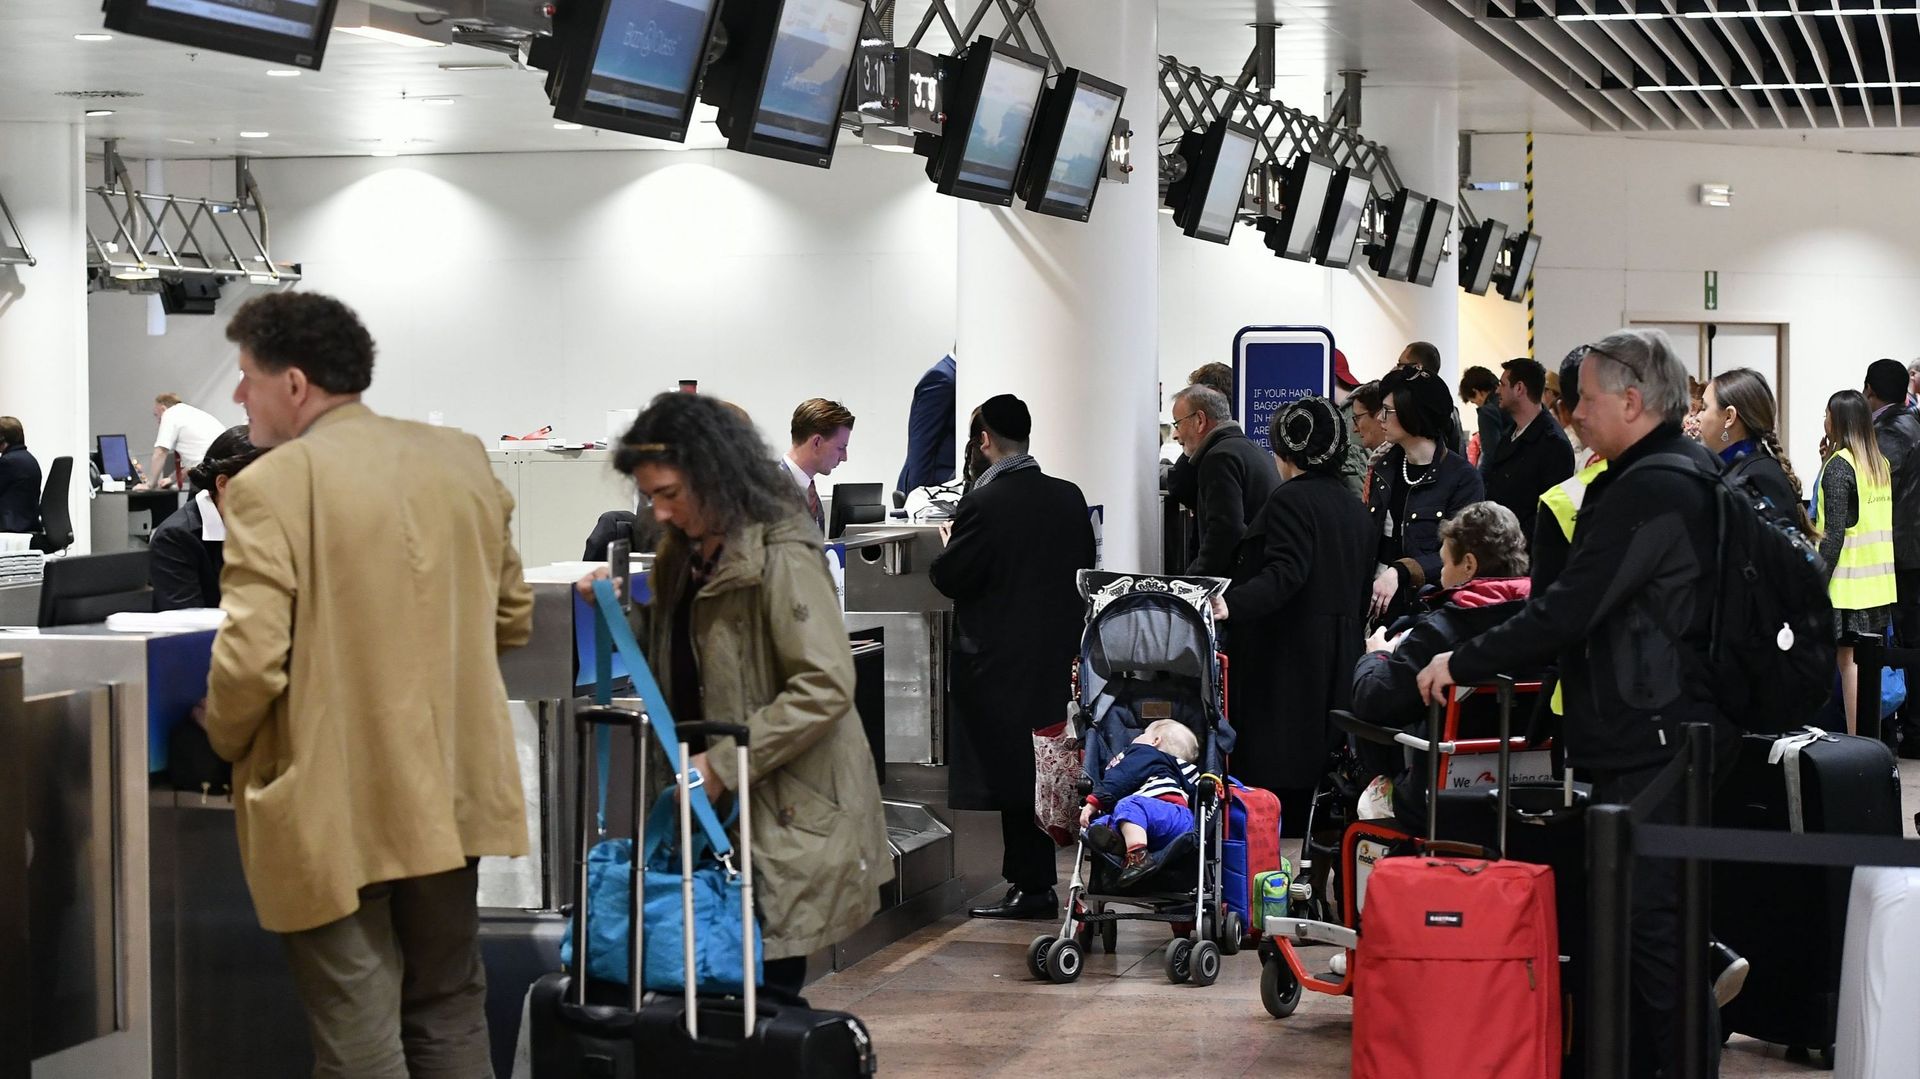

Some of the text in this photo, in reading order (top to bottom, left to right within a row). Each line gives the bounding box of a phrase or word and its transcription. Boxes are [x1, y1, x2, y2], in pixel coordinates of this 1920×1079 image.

[863, 54, 886, 96] 3.10
[913, 72, 936, 112] 3.9
[1253, 388, 1313, 398] IF YOUR HAND
[1253, 414, 1263, 423] IN
[1253, 426, 1270, 435] ARE
[1253, 438, 1270, 448] WEL
[1453, 777, 1471, 788] We
